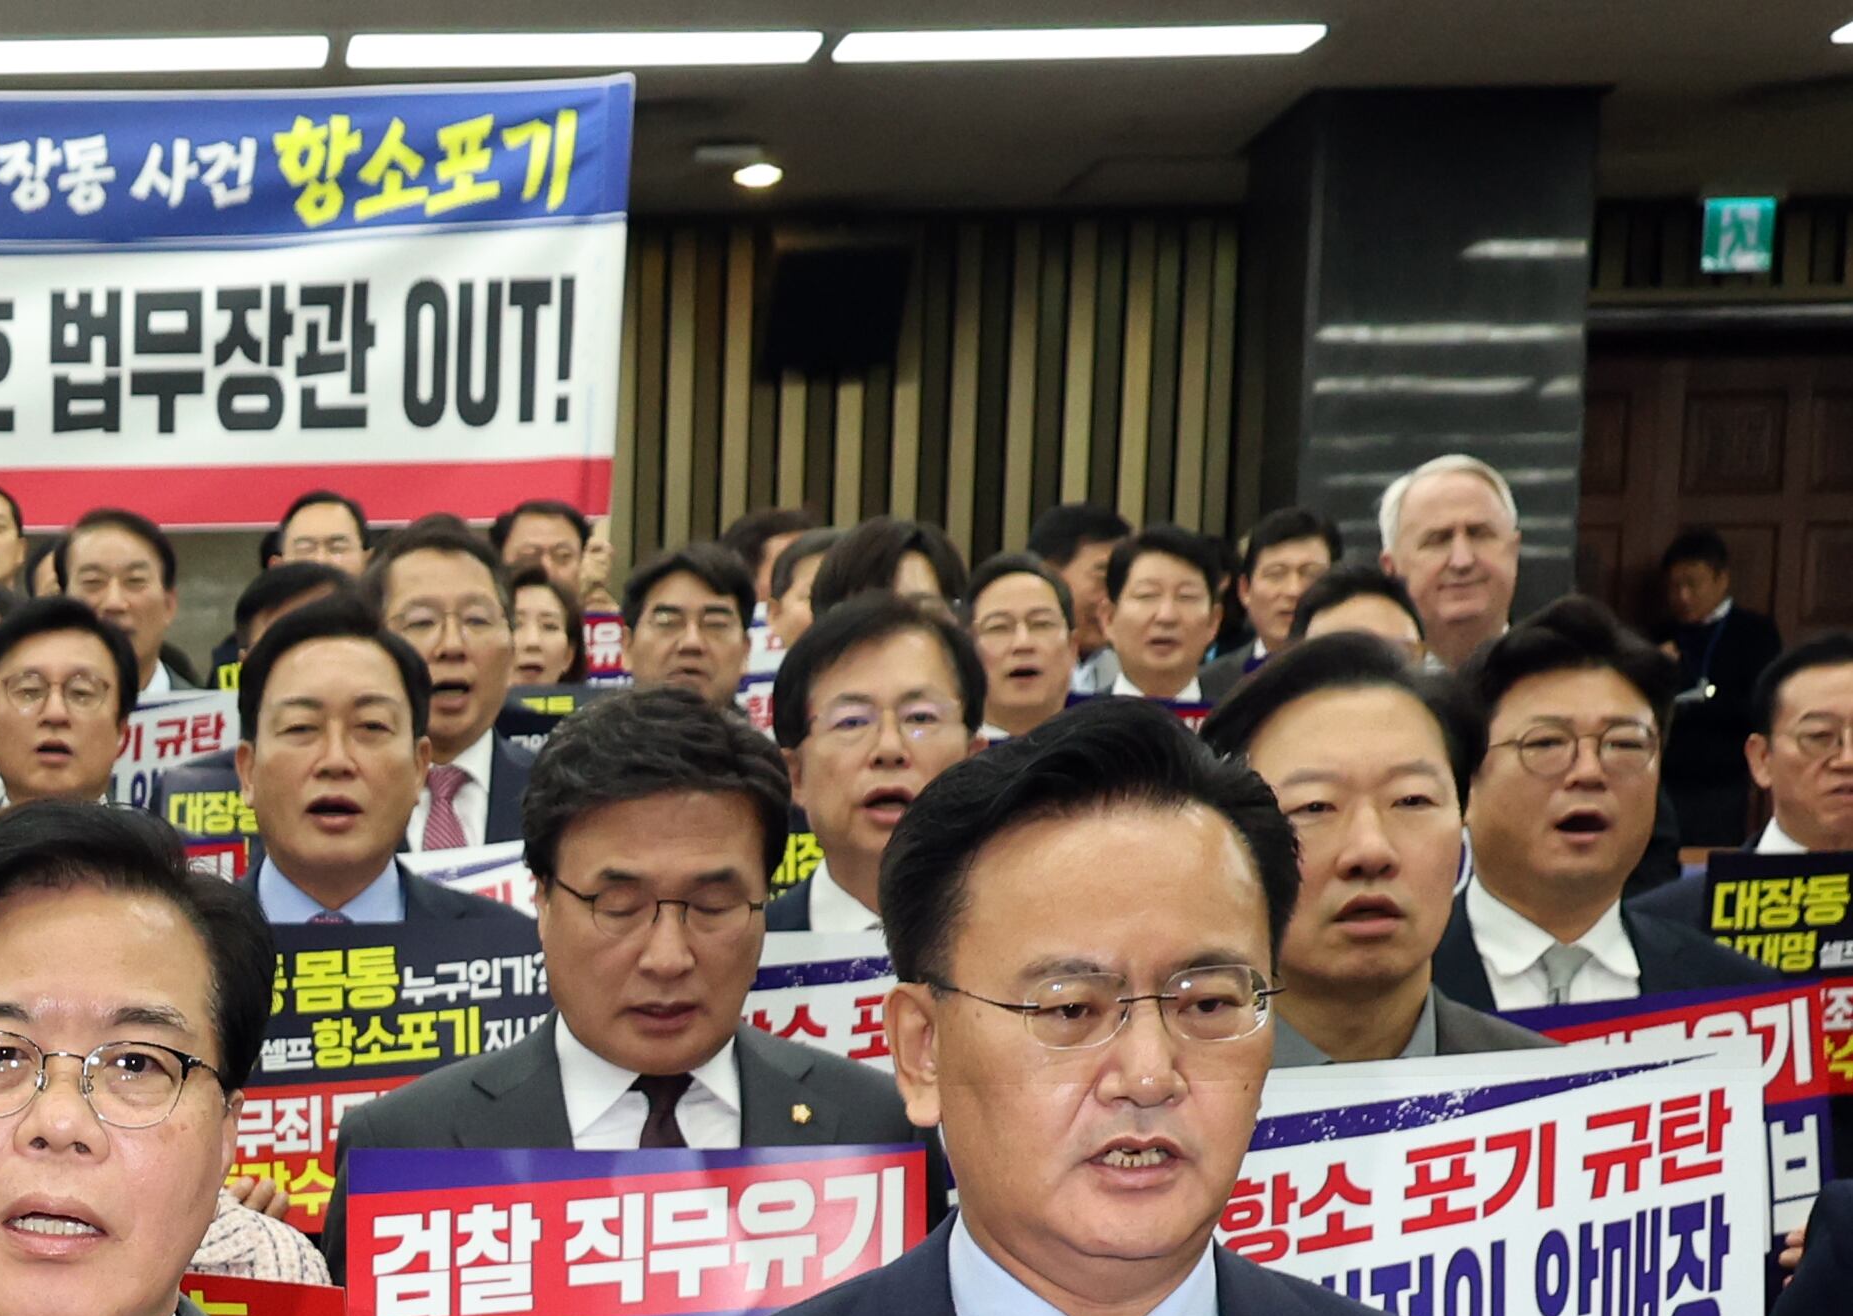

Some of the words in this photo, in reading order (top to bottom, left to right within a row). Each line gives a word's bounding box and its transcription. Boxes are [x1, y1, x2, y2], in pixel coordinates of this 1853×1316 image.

[131, 138, 257, 208] 사건
[274, 109, 577, 227] 항소포기
[51, 281, 376, 433] 법무장관
[404, 275, 575, 428] OUT!
[1711, 873, 1852, 930] 대장동
[292, 945, 400, 1015] 몸통
[311, 1005, 484, 1070] 항소포기
[1218, 1161, 1374, 1264] 항소
[1400, 1120, 1557, 1235] 포기
[1582, 1086, 1733, 1201] 규탄
[564, 1165, 905, 1305] 직무유기
